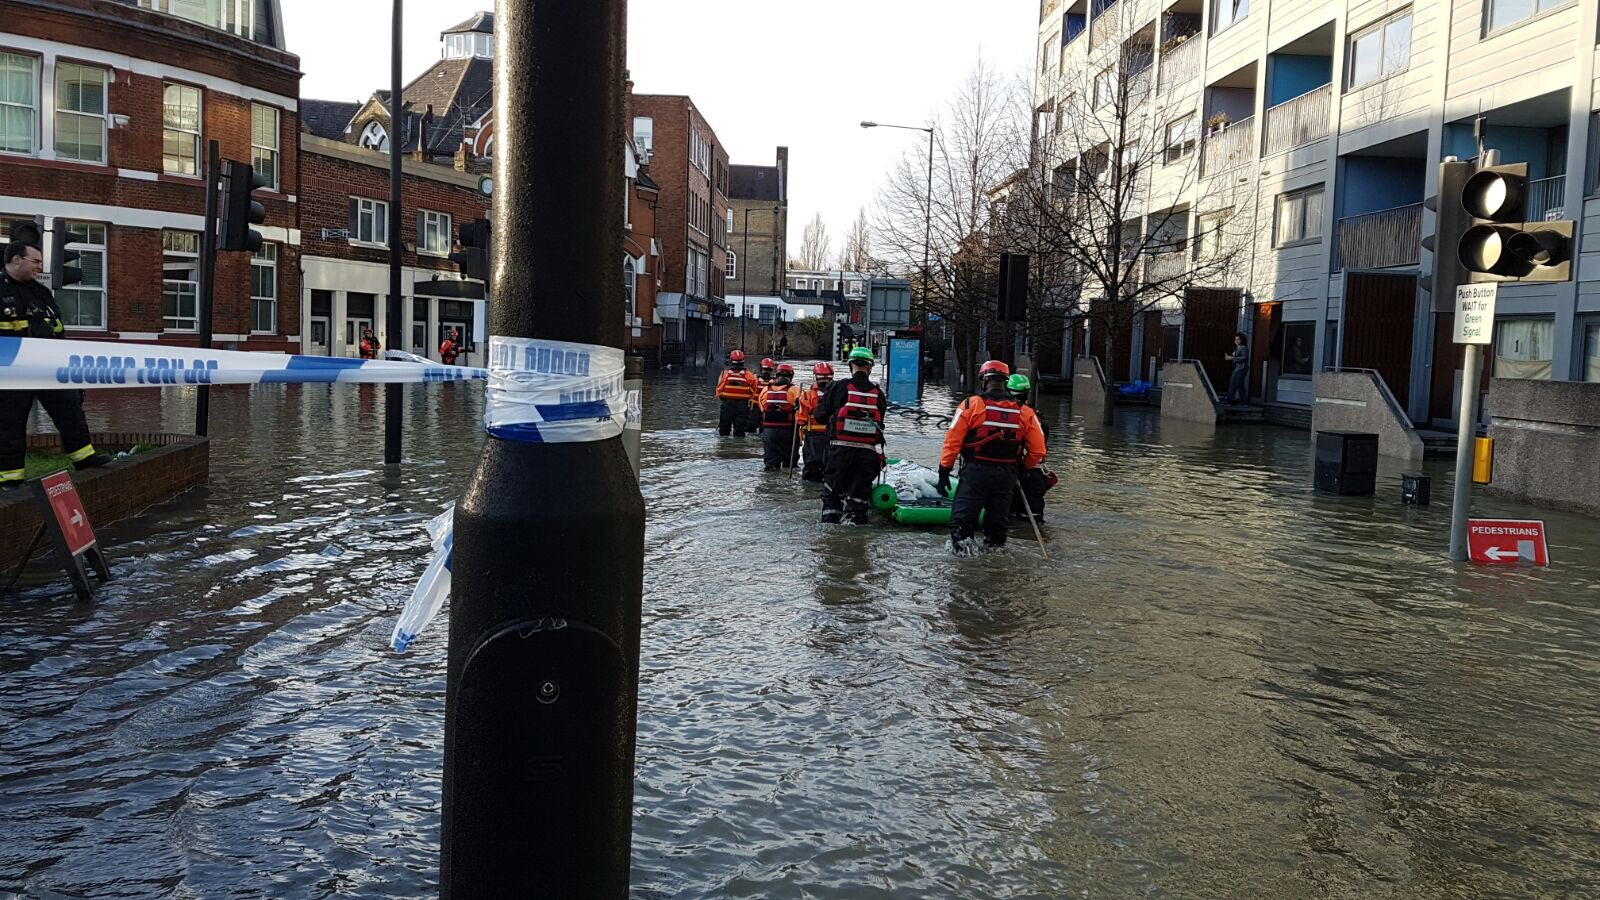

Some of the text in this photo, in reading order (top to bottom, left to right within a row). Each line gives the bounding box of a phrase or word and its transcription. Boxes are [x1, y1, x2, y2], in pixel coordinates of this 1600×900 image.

[1458, 288, 1494, 299] Push Button
[1462, 301, 1487, 311] WAIT for
[1465, 313, 1482, 323] Green
[1463, 326, 1481, 338] Signal
[47, 480, 73, 497] PEDESTRIANS
[1472, 526, 1539, 536] PEDESTRIANS
